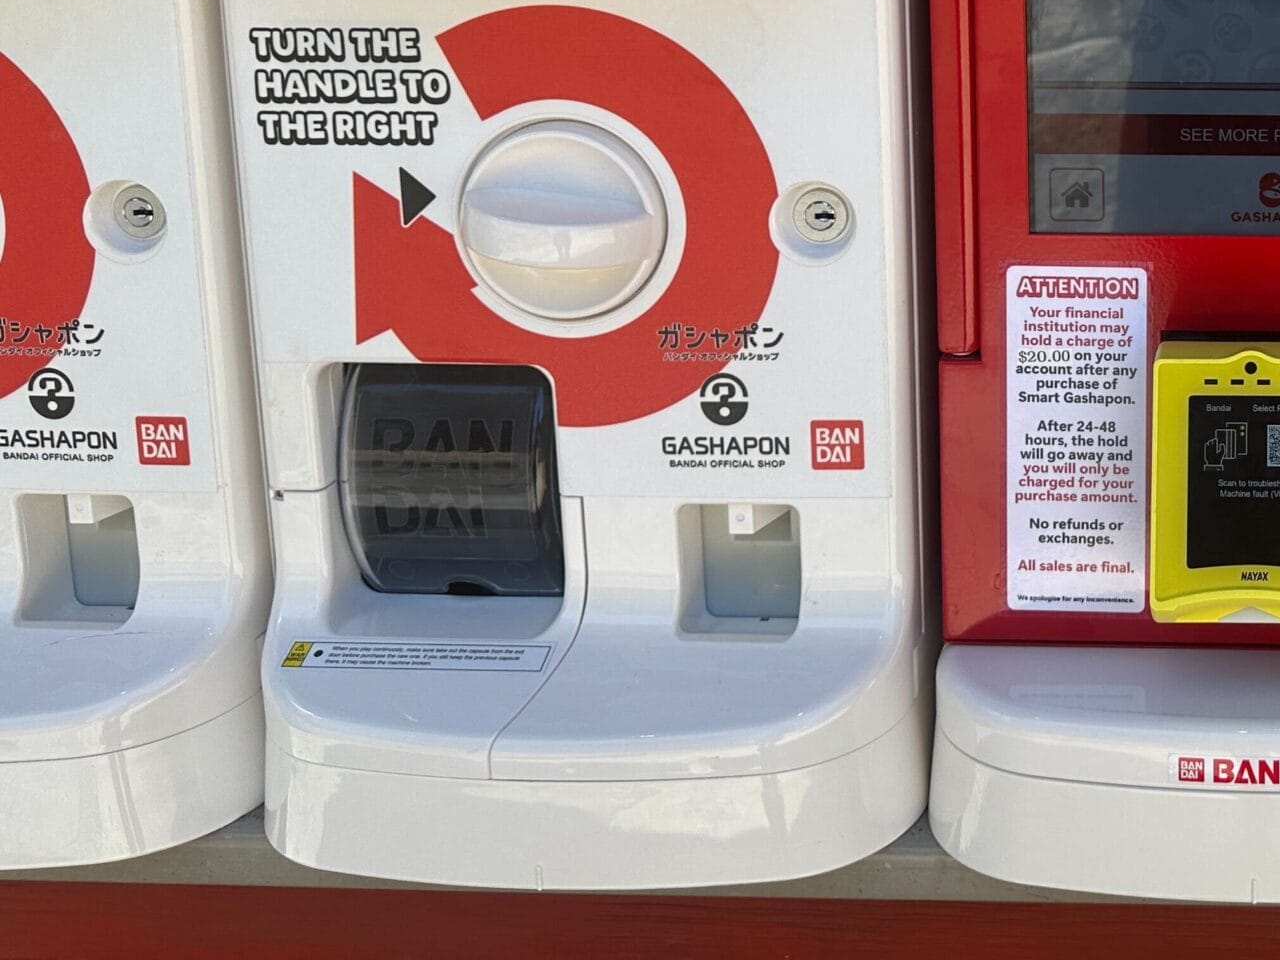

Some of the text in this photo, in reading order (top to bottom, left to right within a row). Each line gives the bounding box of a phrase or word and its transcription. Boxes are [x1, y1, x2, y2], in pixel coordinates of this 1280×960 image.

[250, 27, 421, 62] TURN THE
[255, 69, 451, 104] HANDLE TO
[257, 111, 438, 145] THE RIGHT
[1180, 128, 1214, 142] SEE
[1218, 128, 1270, 143] MORE
[1016, 276, 1139, 300] ATTENTION
[1030, 306, 1124, 319] Your financial
[658, 323, 784, 349] ガシャポン
[1024, 320, 1129, 337] institution may
[1021, 334, 1133, 350] hold a charge of
[1018, 350, 1128, 364] $20.00 on your
[1015, 364, 1137, 379] account after any
[1036, 377, 1119, 391] purchase of
[1018, 391, 1136, 407] Smart Gashapon.
[1206, 403, 1232, 412] Bandai
[1253, 404, 1275, 413] Select
[1037, 420, 1116, 433] After 24-48
[815, 428, 860, 444] BAN
[1025, 434, 1128, 448] hours, the hold
[662, 436, 790, 455] GASHAPON
[3, 452, 114, 462] BANDAI OFFICIAL SHOP
[816, 446, 850, 463] DAI
[1020, 448, 1132, 463] will go away and
[669, 459, 785, 468] BANDAI OFFICIAL SHOP
[1023, 462, 1130, 477] you will only be
[1018, 476, 1134, 491] charged for your
[1218, 479, 1236, 488] Scan
[1238, 479, 1246, 488] to
[1014, 490, 1138, 504] purchase amount.
[1220, 490, 1250, 499] Machine
[1252, 490, 1268, 499] fault
[1029, 518, 1124, 531] No refunds or
[1038, 532, 1114, 547] exchanges.
[1018, 560, 1135, 573] All sales are final.
[1240, 572, 1269, 581] NAYAX
[1180, 761, 1203, 770] BAN
[1180, 770, 1199, 779] DAI
